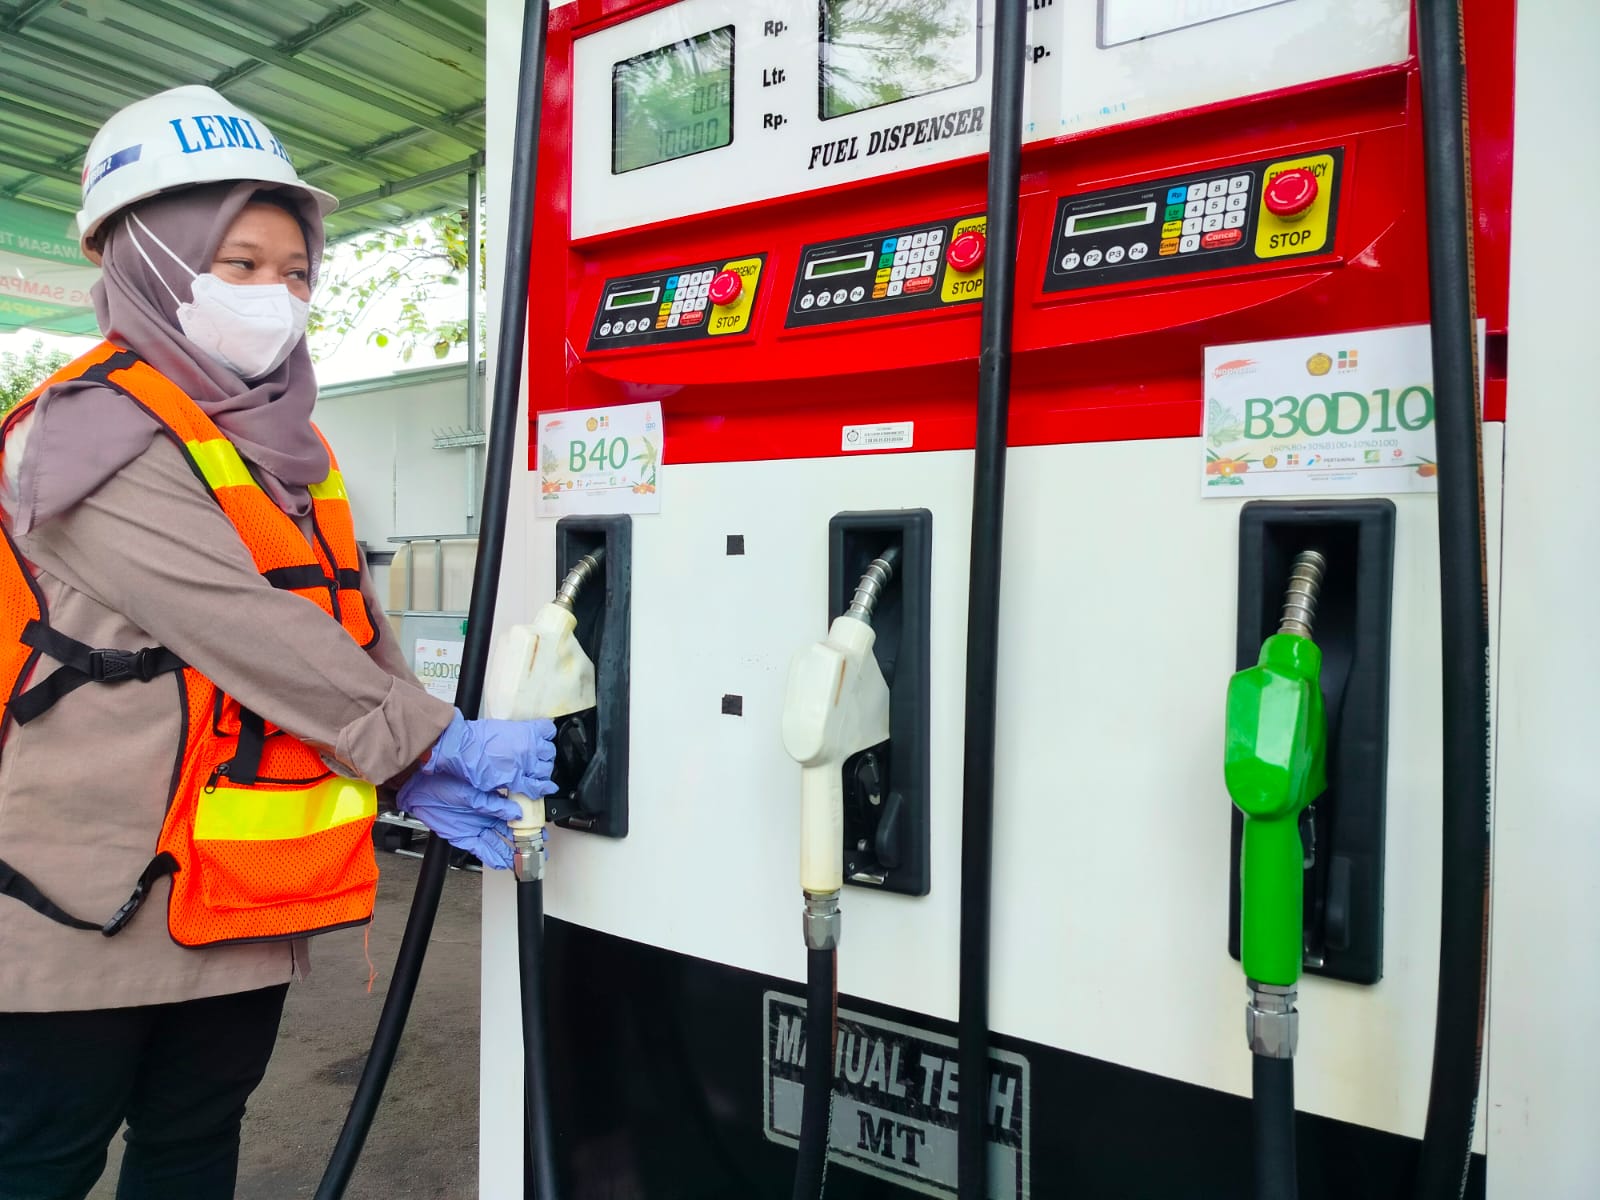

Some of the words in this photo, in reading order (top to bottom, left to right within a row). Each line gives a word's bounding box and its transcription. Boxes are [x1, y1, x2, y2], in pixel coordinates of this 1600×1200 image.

[764, 20, 788, 37] Rp.
[763, 67, 786, 87] Ltr.
[763, 113, 788, 130] Rp.
[169, 114, 265, 154] LEMI
[808, 136, 859, 170] FUEL
[866, 106, 985, 156] DISPENSER
[1193, 188, 1200, 196] 7
[1214, 184, 1221, 192] 8
[1235, 180, 1242, 189] 9
[1211, 201, 1218, 209] 5
[1233, 198, 1240, 206] 6
[1191, 222, 1195, 230] 1
[1210, 219, 1217, 227] 2
[1231, 215, 1237, 224] 3
[1186, 239, 1193, 247] 0
[1206, 229, 1237, 241] Cancel
[1269, 230, 1311, 249] STOP
[1065, 257, 1077, 266] P1
[1086, 253, 1099, 262] P2
[1108, 251, 1121, 260] P3
[1131, 247, 1144, 256] P4
[911, 267, 917, 275] 2
[926, 264, 931, 272] 3
[906, 277, 930, 287] Cancel
[951, 278, 983, 295] STOP
[802, 298, 812, 306] P1
[818, 294, 829, 302] P2
[835, 292, 846, 300] P3
[851, 290, 862, 299] P4
[717, 315, 741, 329] STOP
[1243, 385, 1435, 440] B30D10
[569, 436, 629, 472] B40
[920, 1052, 1017, 1131] TEH
[857, 1110, 925, 1168] MT
